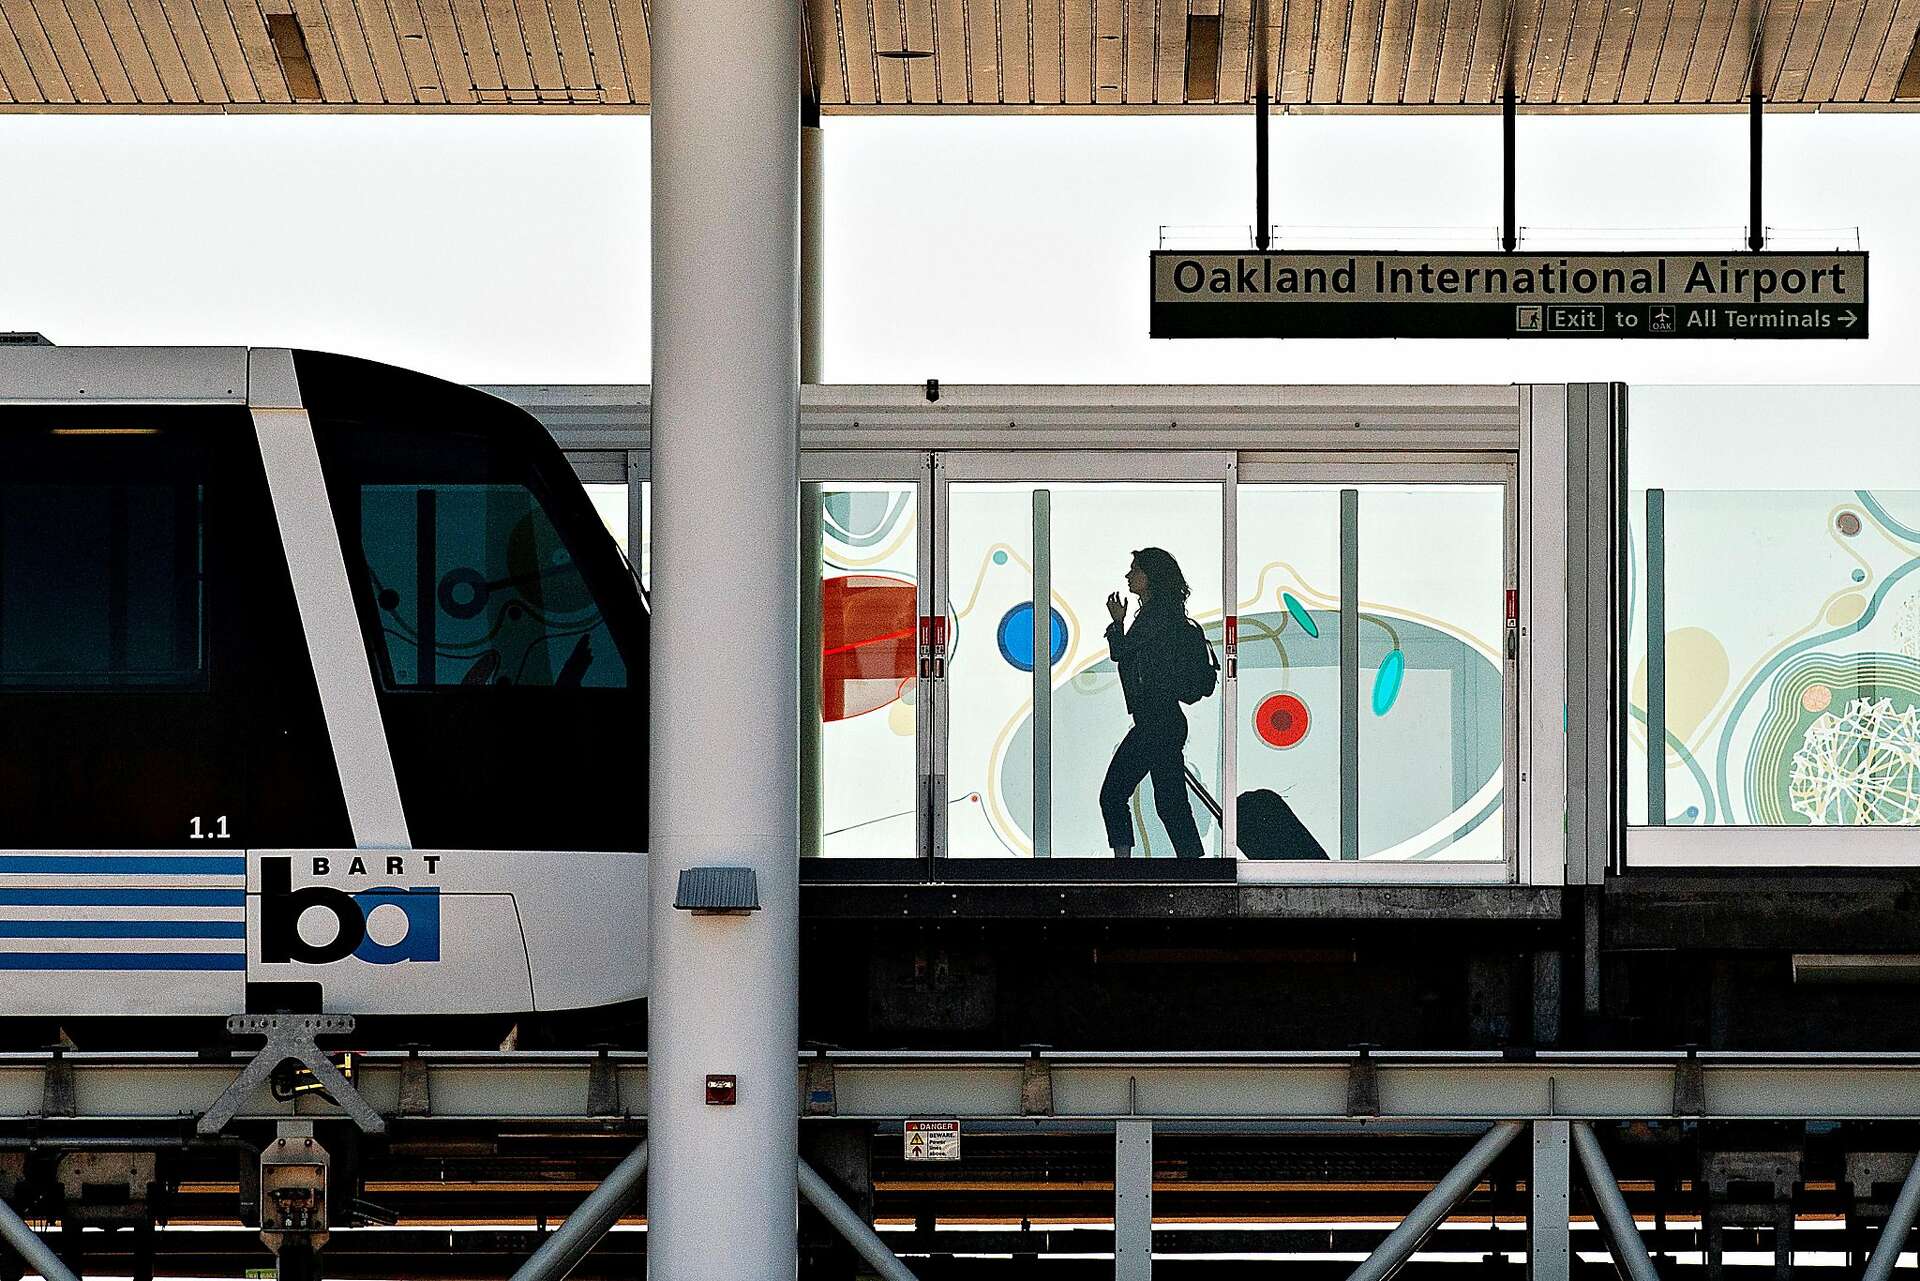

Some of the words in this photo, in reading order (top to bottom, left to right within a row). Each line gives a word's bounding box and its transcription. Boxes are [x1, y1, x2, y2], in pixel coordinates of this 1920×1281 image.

[1173, 258, 1356, 294] Oakland
[1375, 258, 1666, 294] International
[1684, 259, 1846, 302] Airport
[1555, 310, 1596, 327] Exit
[1615, 311, 1639, 327] to
[1687, 309, 1717, 327] All
[1724, 309, 1831, 327] Terminals
[189, 815, 231, 839] 1.1
[312, 856, 441, 875] BART
